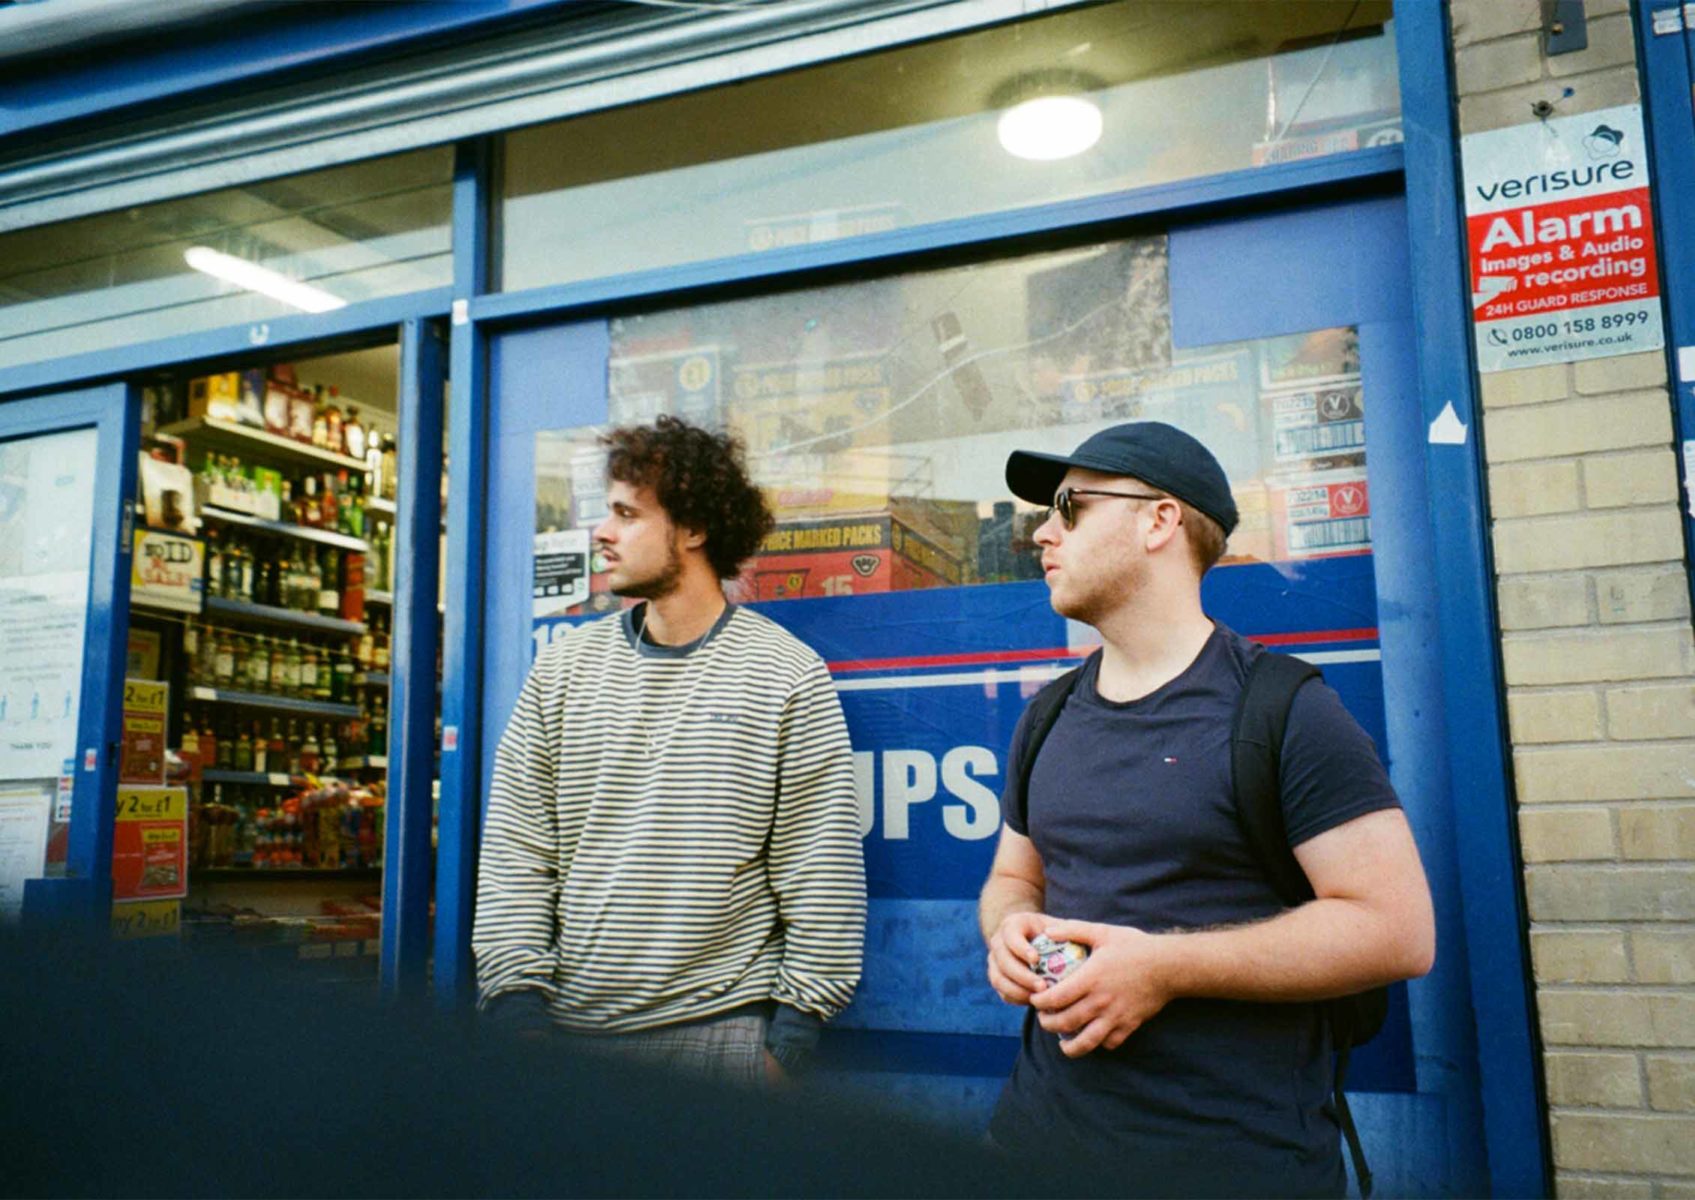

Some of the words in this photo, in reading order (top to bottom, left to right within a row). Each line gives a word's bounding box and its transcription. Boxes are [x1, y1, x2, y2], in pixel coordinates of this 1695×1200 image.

[1477, 160, 1635, 201] verisure
[1480, 204, 1643, 253] Alarm
[1480, 246, 1553, 273] Images
[1559, 245, 1575, 261] &
[1581, 235, 1644, 258] Audio
[1525, 257, 1646, 288] recording
[1486, 300, 1514, 317] 24H
[1516, 293, 1567, 313] GUARD
[1571, 283, 1648, 304] RESPONSE
[1512, 323, 1558, 342] 0800
[1564, 317, 1596, 335] 158
[1602, 310, 1649, 329] 8999
[1507, 332, 1633, 358] www.verisure.co.uk
[794, 528, 841, 548] MARKED
[843, 524, 882, 546] PACKS
[821, 574, 854, 597] 15
[125, 686, 135, 702] 2
[128, 795, 139, 813] 2
